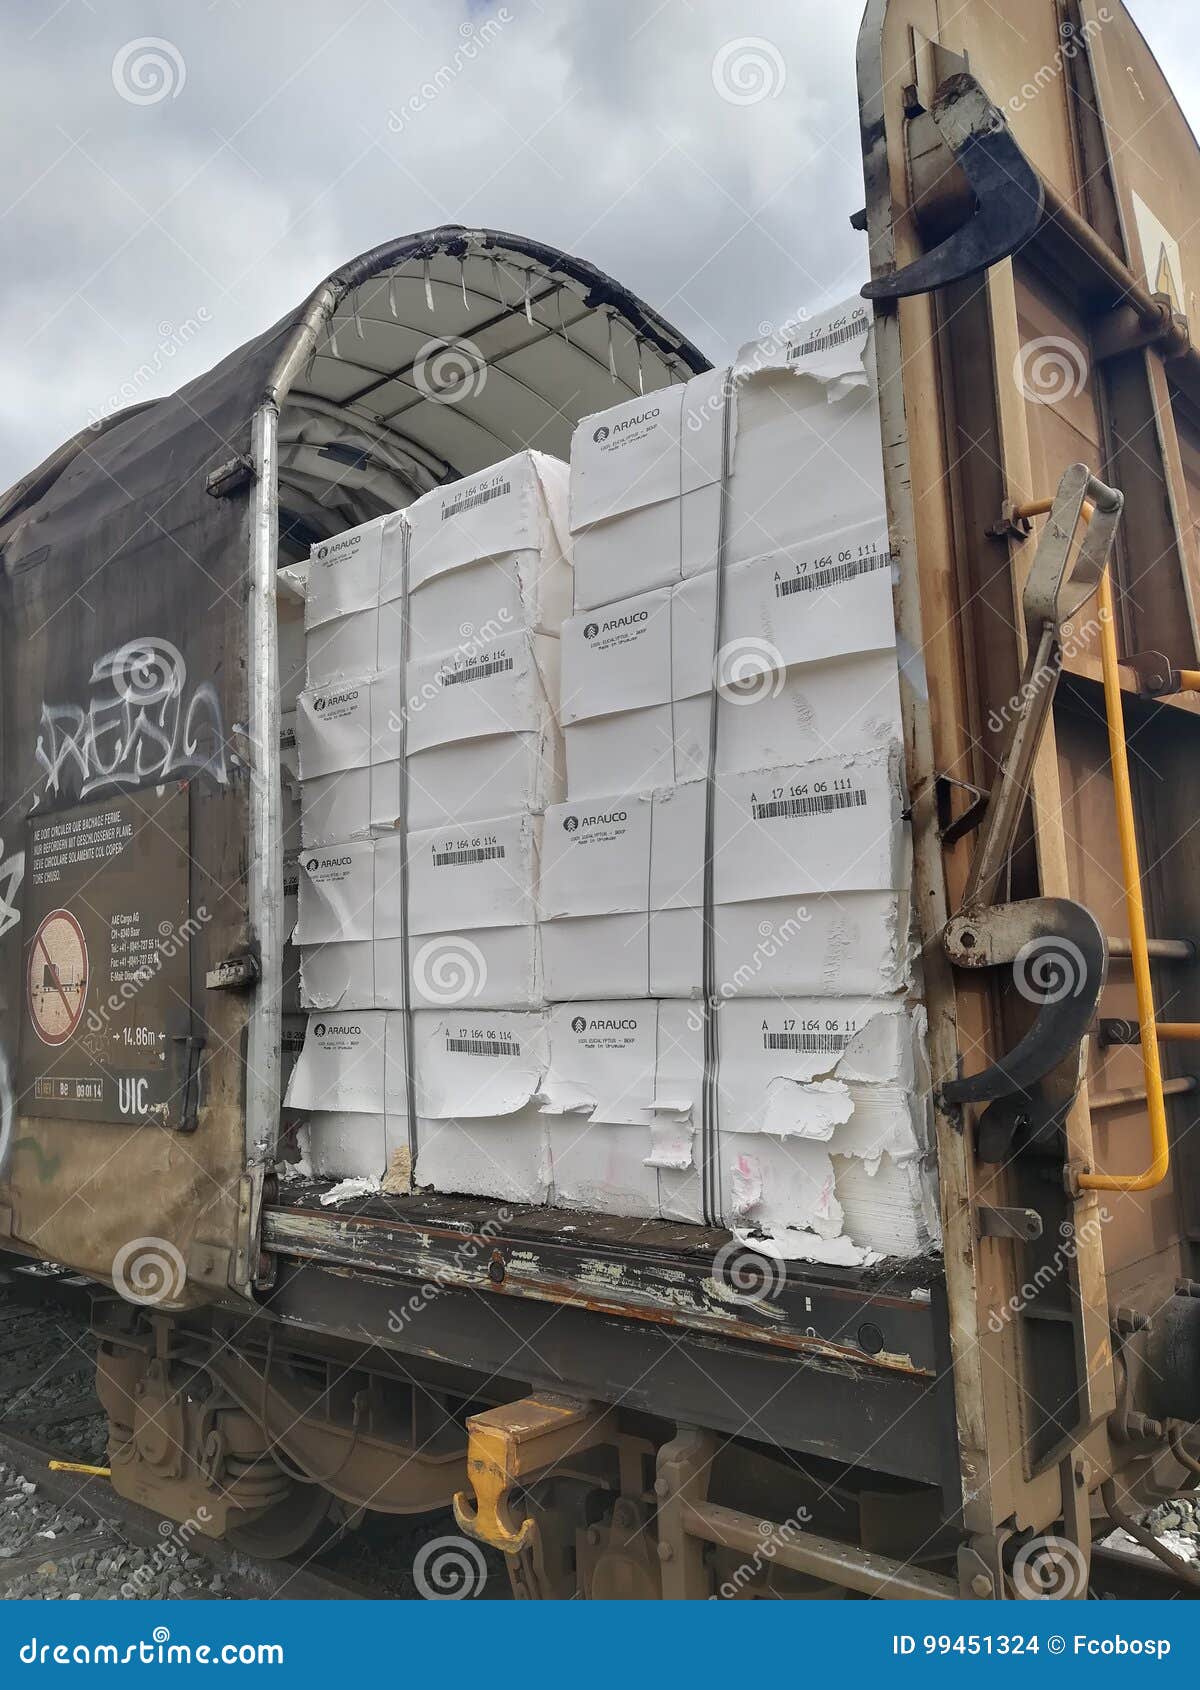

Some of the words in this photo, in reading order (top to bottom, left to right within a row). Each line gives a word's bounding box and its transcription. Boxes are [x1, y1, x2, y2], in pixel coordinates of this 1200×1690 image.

[809, 328, 822, 341] 17
[827, 317, 848, 334] 164
[851, 307, 865, 320] 06
[613, 408, 660, 434] ARAUCO
[454, 493, 462, 502] 17
[479, 482, 488, 491] 06
[330, 535, 361, 553] ARAUCO
[774, 571, 781, 581] A
[796, 562, 807, 575] 17
[814, 555, 833, 570] 164
[838, 550, 852, 562] 06
[858, 542, 877, 557] 111
[602, 611, 648, 632] ARAUCO
[464, 656, 478, 667] 164
[480, 653, 489, 662] 06
[328, 691, 359, 706] ARAUCO
[751, 793, 757, 803] A
[771, 787, 783, 799] 17
[789, 784, 808, 797] 164
[814, 781, 827, 793] 06
[833, 778, 852, 790] 111
[582, 811, 627, 827] ARAUCO
[445, 842, 453, 851] 17
[457, 839, 470, 849] 164
[471, 838, 480, 846] 06
[321, 856, 352, 868] ARAUCO
[328, 1026, 361, 1035] ARAUCO
[590, 1019, 637, 1030] ARAUCO
[761, 1020, 768, 1031] A
[783, 1020, 795, 1031] 17
[801, 1020, 820, 1031] 164
[825, 1020, 839, 1031] 06
[123, 1027, 155, 1046] 14.86m
[459, 1029, 467, 1038] 17
[471, 1029, 484, 1039] 164
[486, 1030, 496, 1039] 06
[119, 1077, 149, 1114] UIC
